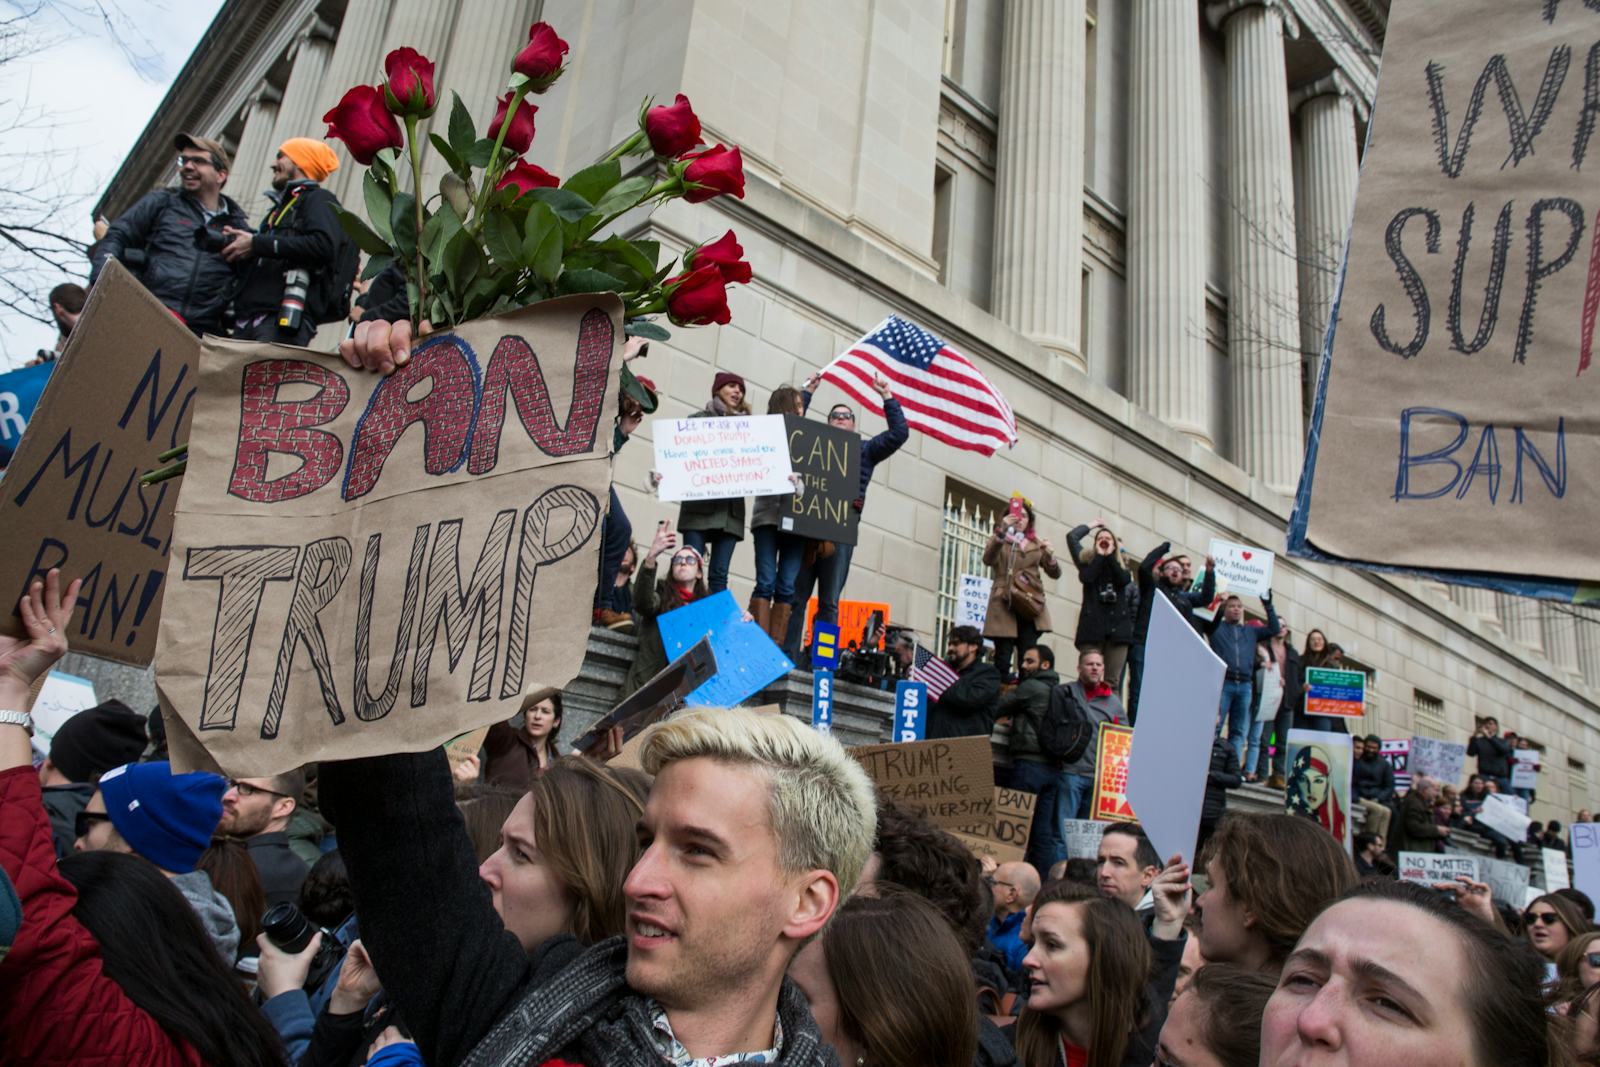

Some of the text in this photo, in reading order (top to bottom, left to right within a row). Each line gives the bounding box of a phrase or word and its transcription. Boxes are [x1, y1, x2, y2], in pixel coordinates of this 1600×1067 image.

[227, 307, 616, 503] BAN
[790, 429, 849, 479] CAN
[1391, 406, 1566, 505] BAN
[804, 473, 828, 492] THE
[792, 493, 849, 527] BAN!
[1217, 568, 1259, 585] Neighbor
[1230, 560, 1265, 576] Muslim
[184, 484, 600, 740] TRUMP
[857, 743, 954, 780] TRUMP:
[879, 774, 970, 800] FEARING
[999, 789, 1033, 811] BAN
[1405, 857, 1426, 869] NO
[1432, 858, 1475, 871] MATTER
